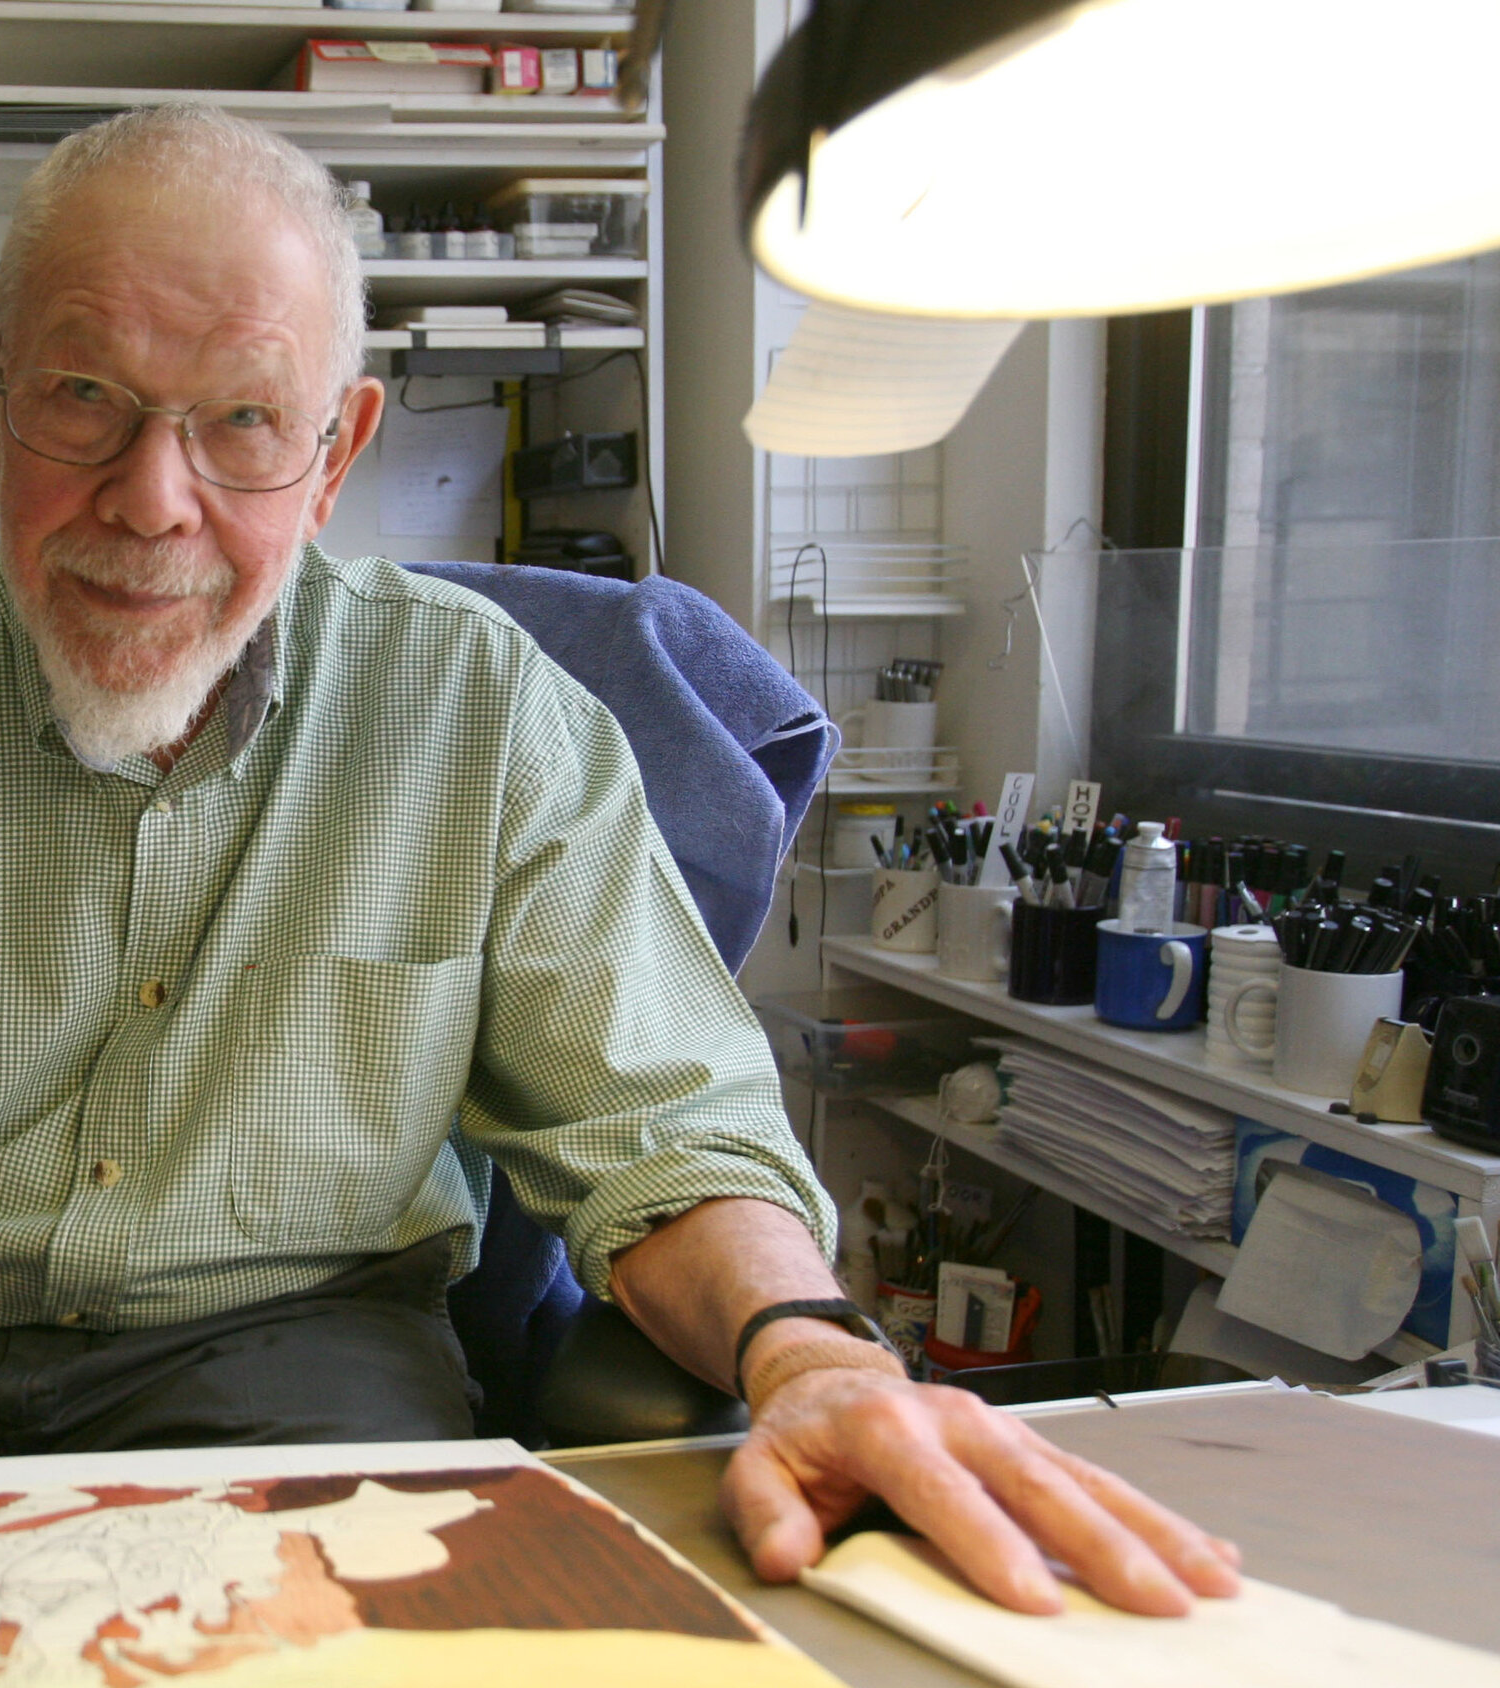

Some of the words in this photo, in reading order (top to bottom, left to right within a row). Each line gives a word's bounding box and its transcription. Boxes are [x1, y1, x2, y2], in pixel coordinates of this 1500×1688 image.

[1001, 776, 1023, 837] COOL
[1072, 785, 1092, 829] HOT
[883, 887, 939, 940] GRANDP
